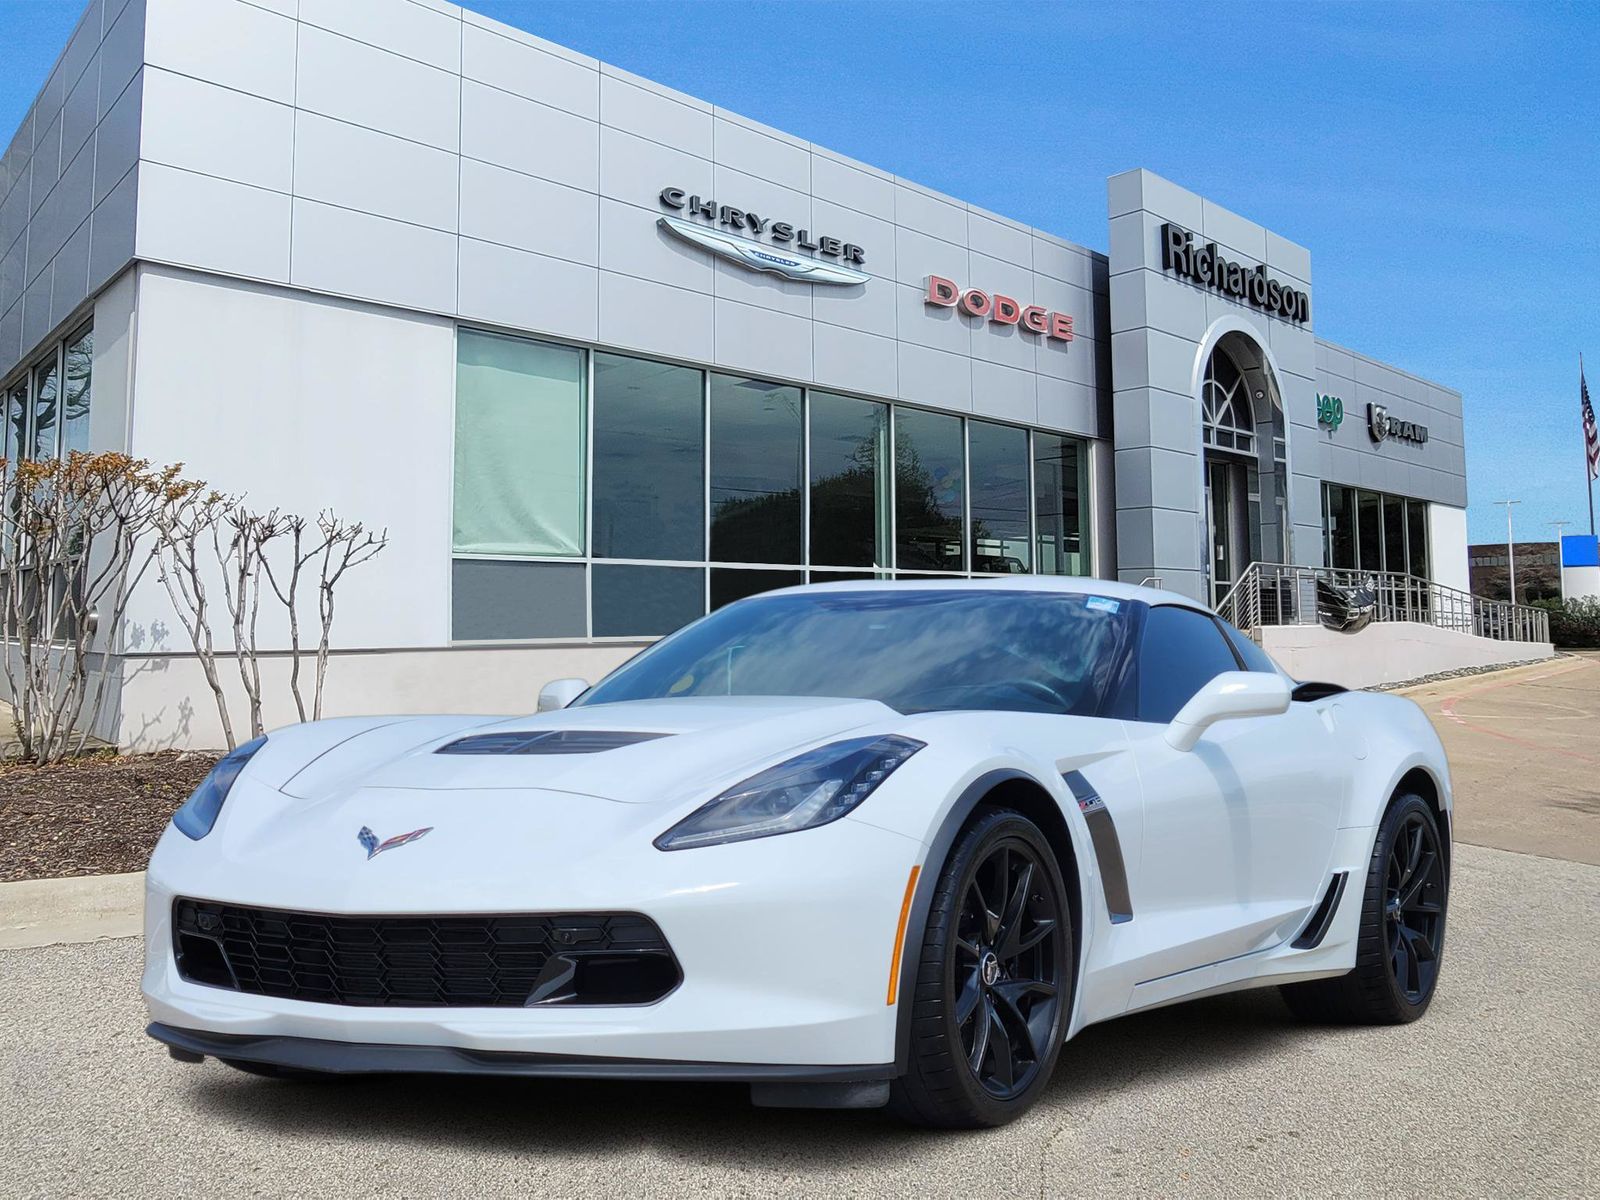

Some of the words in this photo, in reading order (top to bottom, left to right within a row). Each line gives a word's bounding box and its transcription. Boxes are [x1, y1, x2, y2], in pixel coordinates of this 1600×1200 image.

[659, 187, 866, 264] CHRYSLER
[923, 274, 1073, 342] DODGE
[1161, 223, 1310, 324] Richardson
[1387, 416, 1429, 443] RAM
